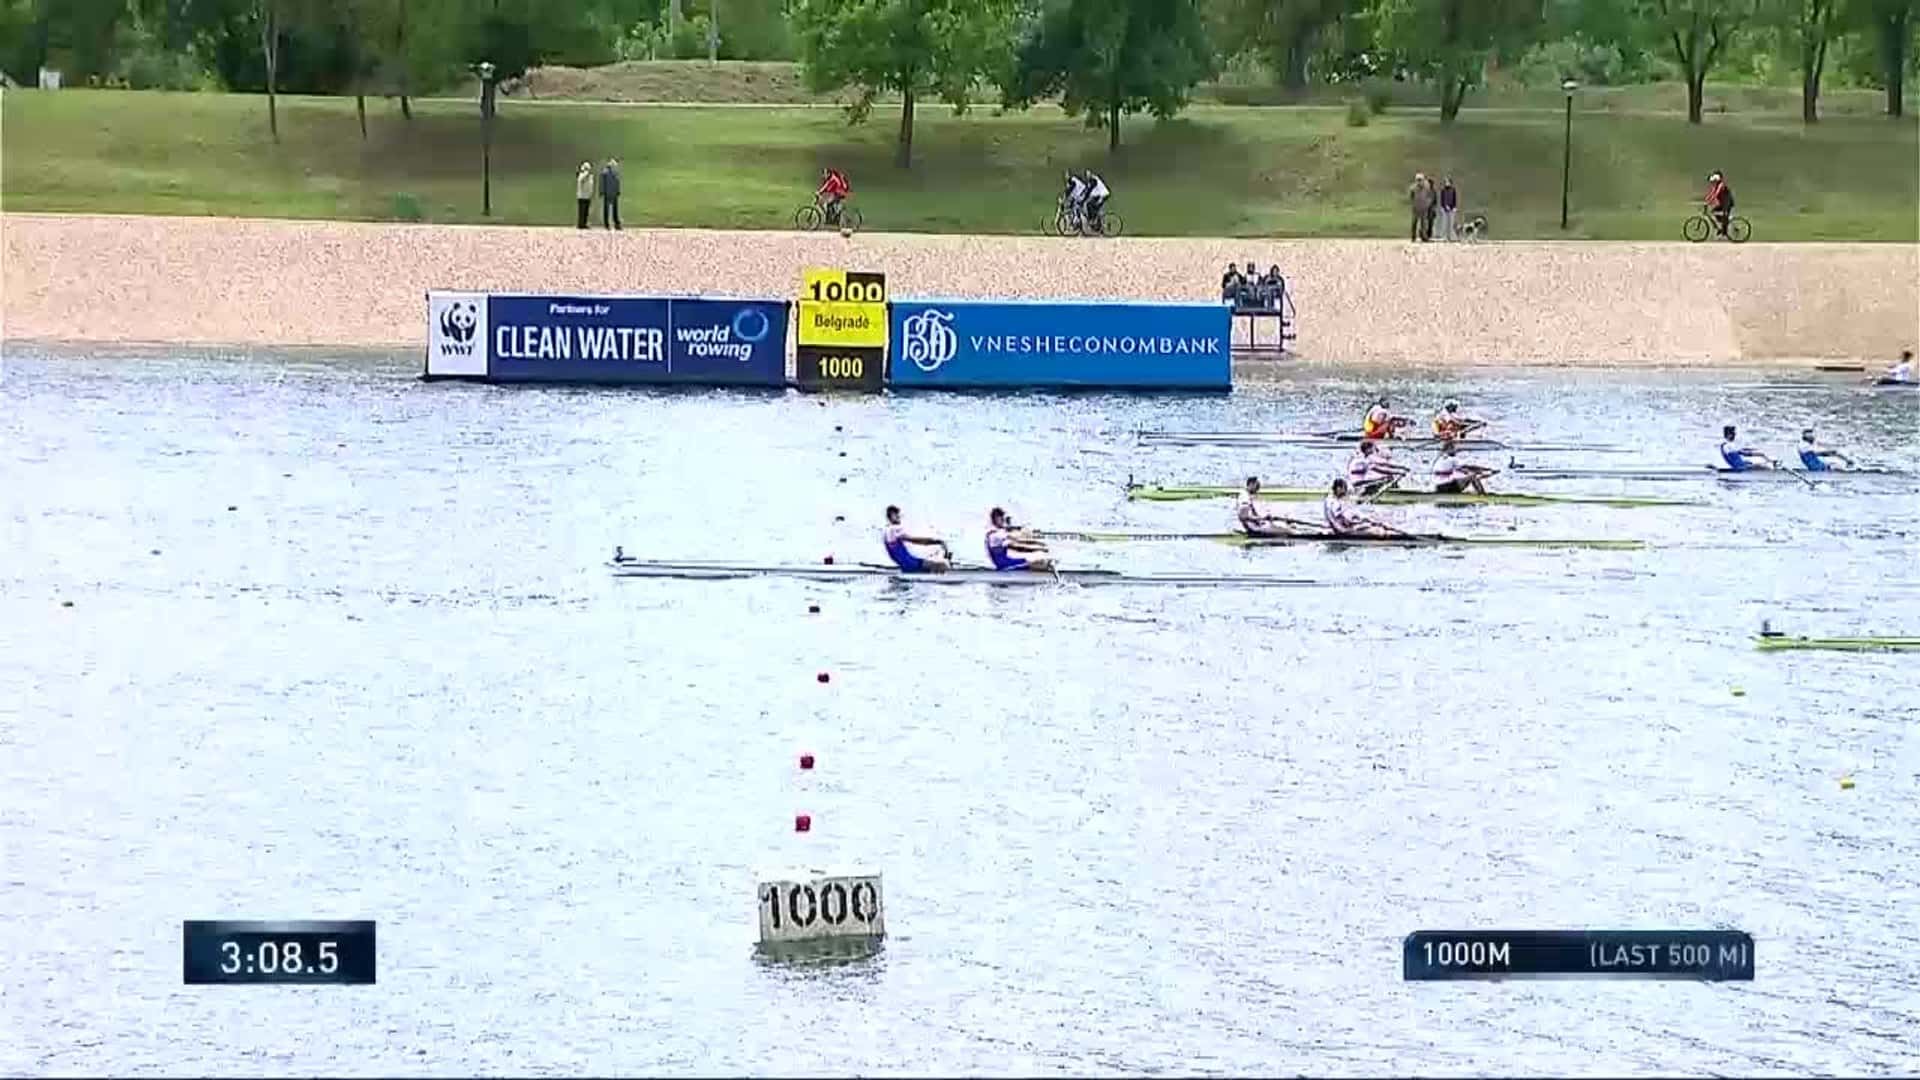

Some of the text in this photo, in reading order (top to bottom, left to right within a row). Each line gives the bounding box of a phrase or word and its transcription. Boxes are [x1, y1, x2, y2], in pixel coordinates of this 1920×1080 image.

[809, 279, 884, 302] 1000
[550, 303, 610, 316] Partners for
[814, 314, 870, 331] Belgrade
[496, 325, 664, 361] CLEAN WATER
[676, 325, 730, 343] world
[687, 341, 752, 361] rowing
[970, 335, 1220, 354] VNESHECONOMBANK
[818, 356, 863, 378] 1000
[761, 881, 878, 929] 1000
